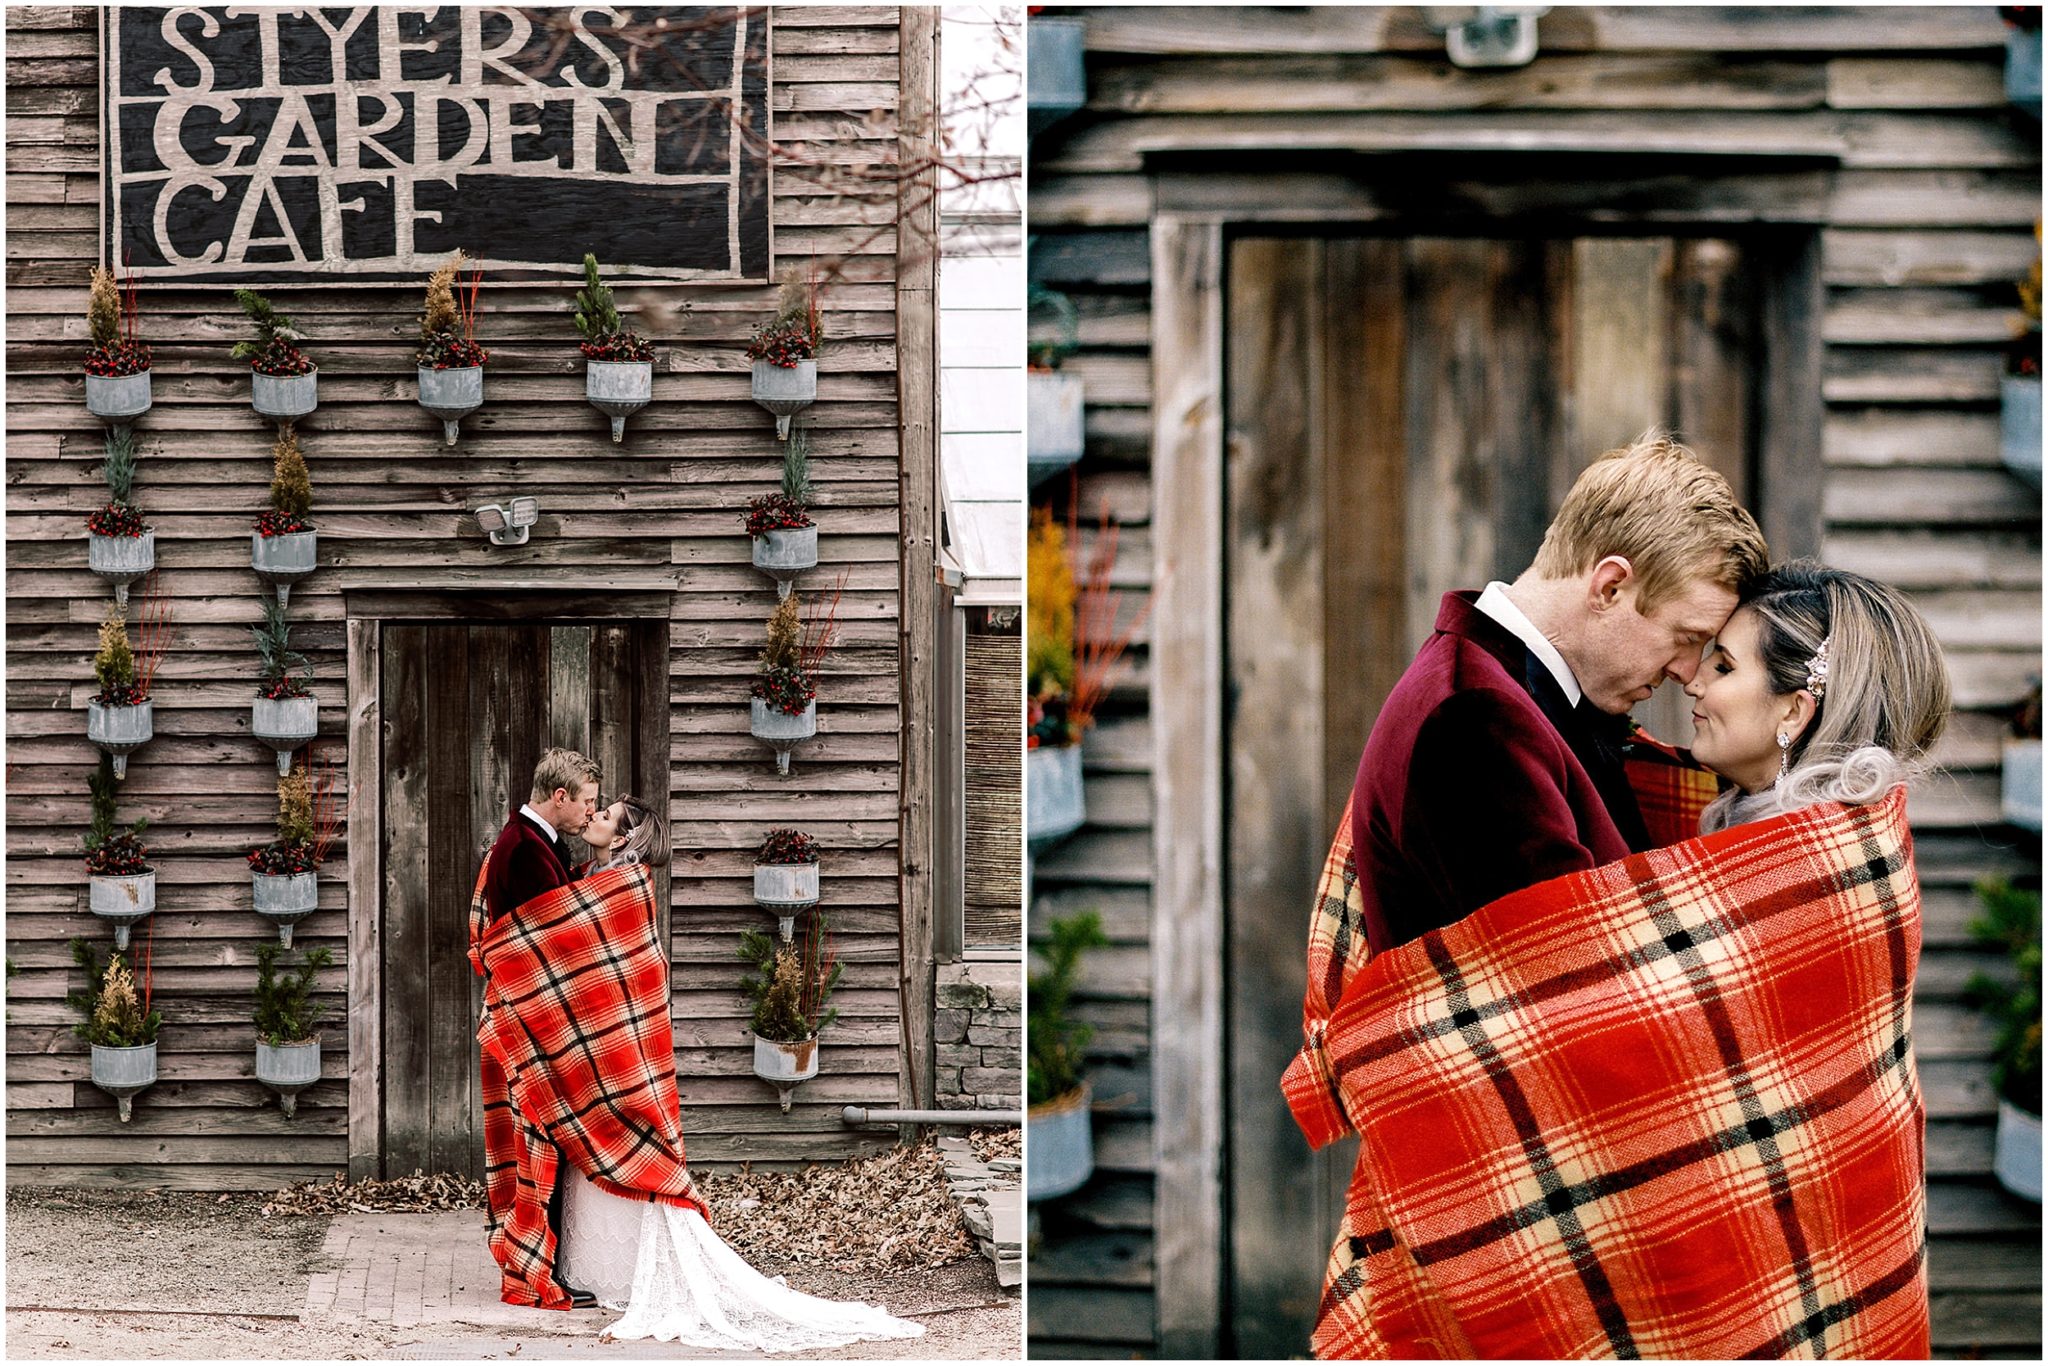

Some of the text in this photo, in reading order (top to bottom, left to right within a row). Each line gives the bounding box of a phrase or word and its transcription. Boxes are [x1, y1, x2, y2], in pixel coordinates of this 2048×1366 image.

[153, 6, 628, 93] STYERS
[153, 94, 656, 175] GARDEN
[153, 173, 463, 265] CAFE
